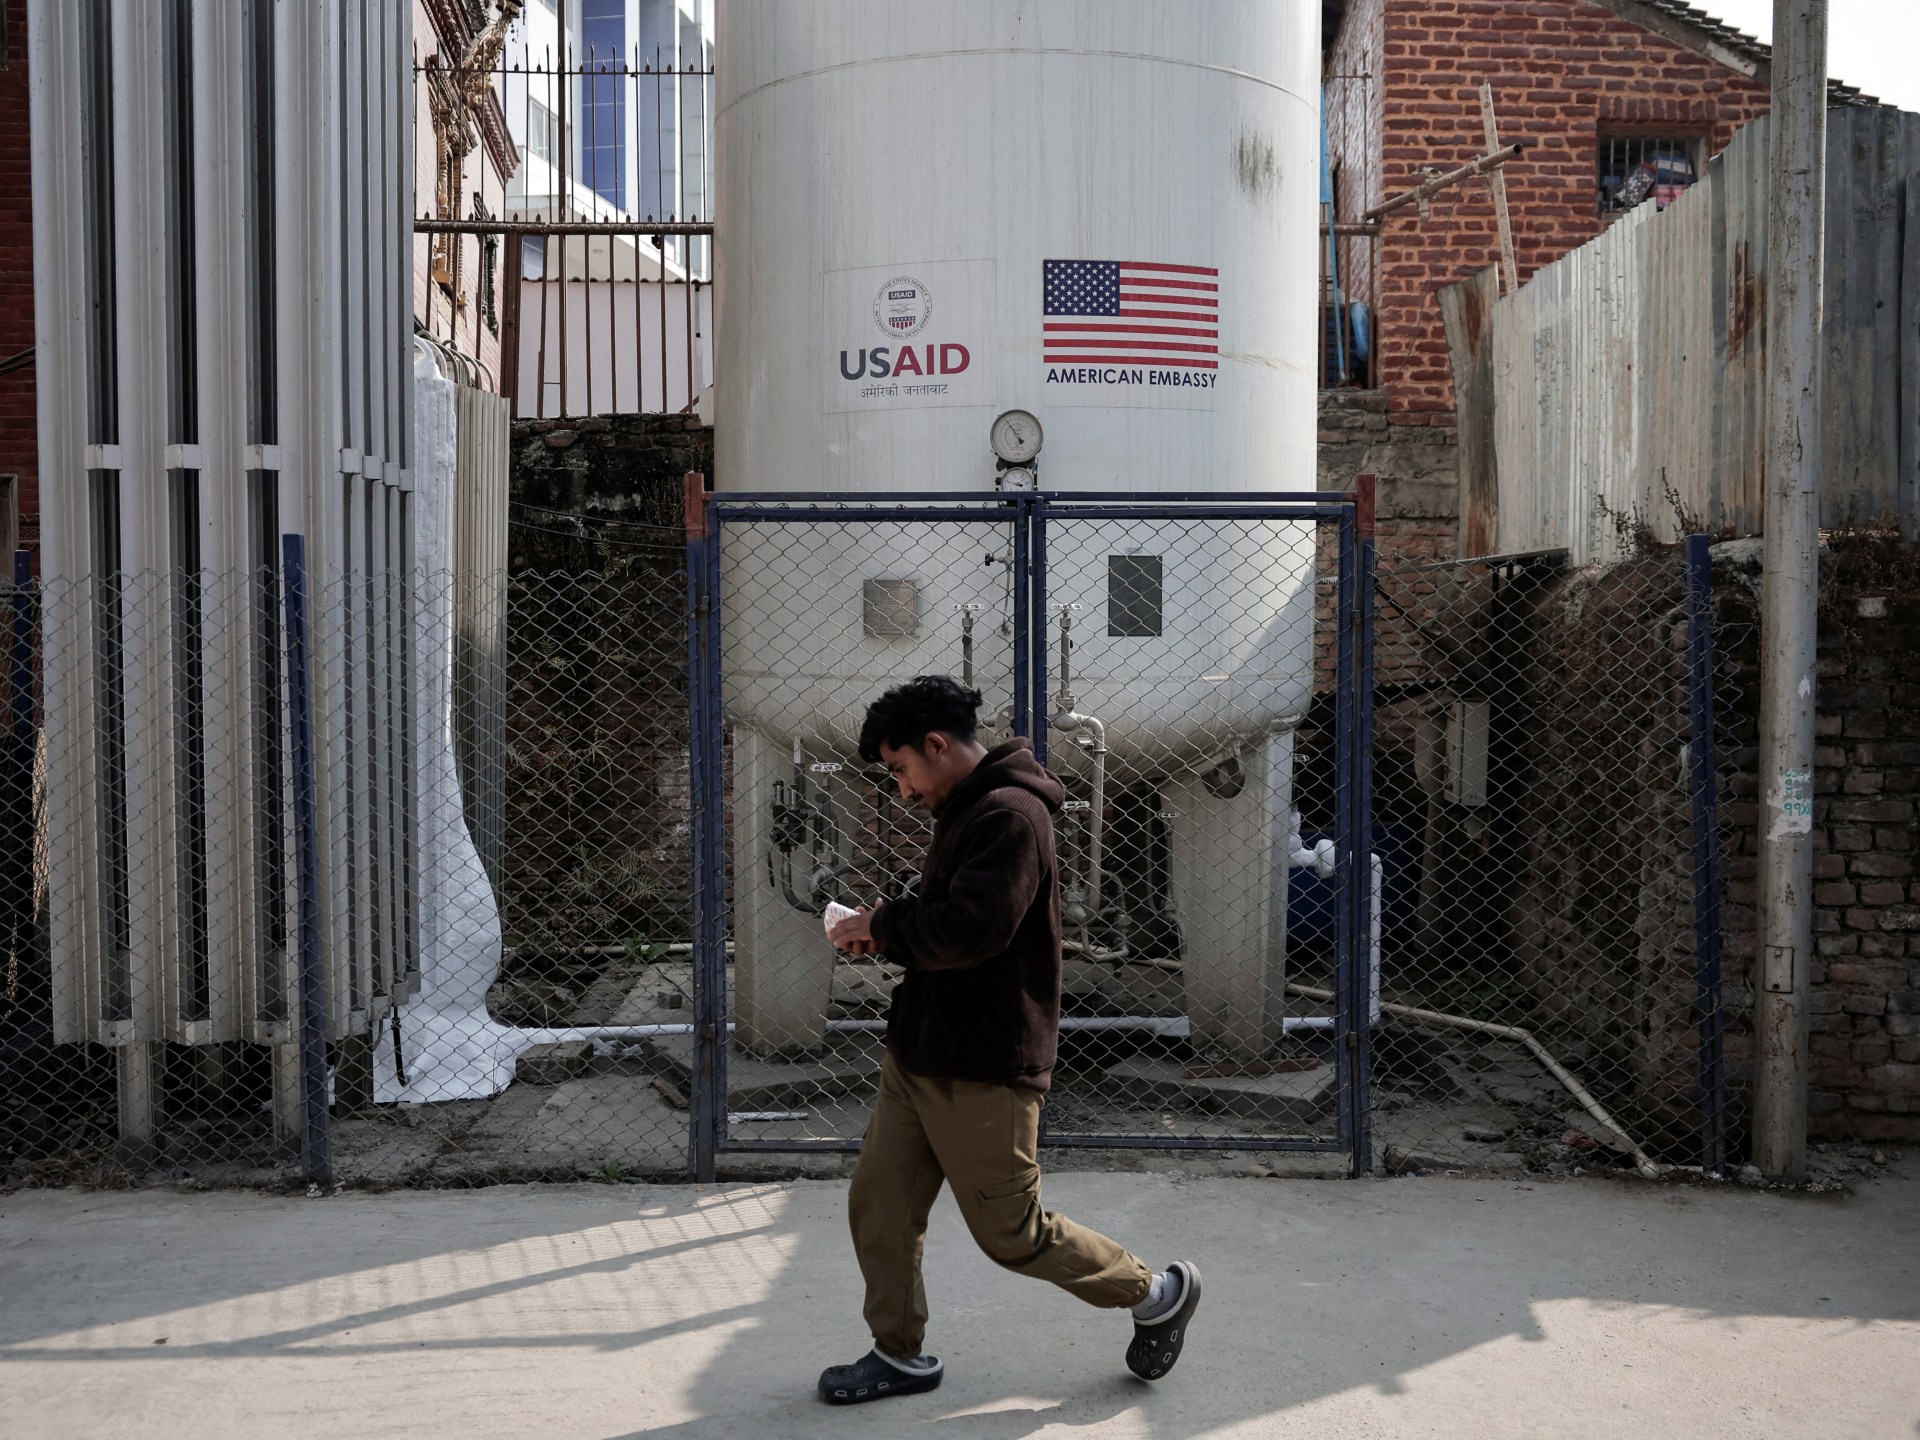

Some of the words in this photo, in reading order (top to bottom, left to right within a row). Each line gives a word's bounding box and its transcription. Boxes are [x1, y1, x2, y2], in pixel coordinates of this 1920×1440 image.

[877, 282, 892, 300] UNITED
[911, 279, 928, 296] AGENCY
[890, 291, 913, 299] USAID
[874, 310, 904, 338] INTERNATIONAL
[904, 306, 930, 338] DEVELOPMENT
[840, 343, 970, 380] USAID
[1046, 368, 1143, 385] AMERICAN
[1149, 370, 1217, 388] EMBASSY
[860, 383, 898, 398] अमेरिकी
[903, 384, 948, 396] जनताबाट
